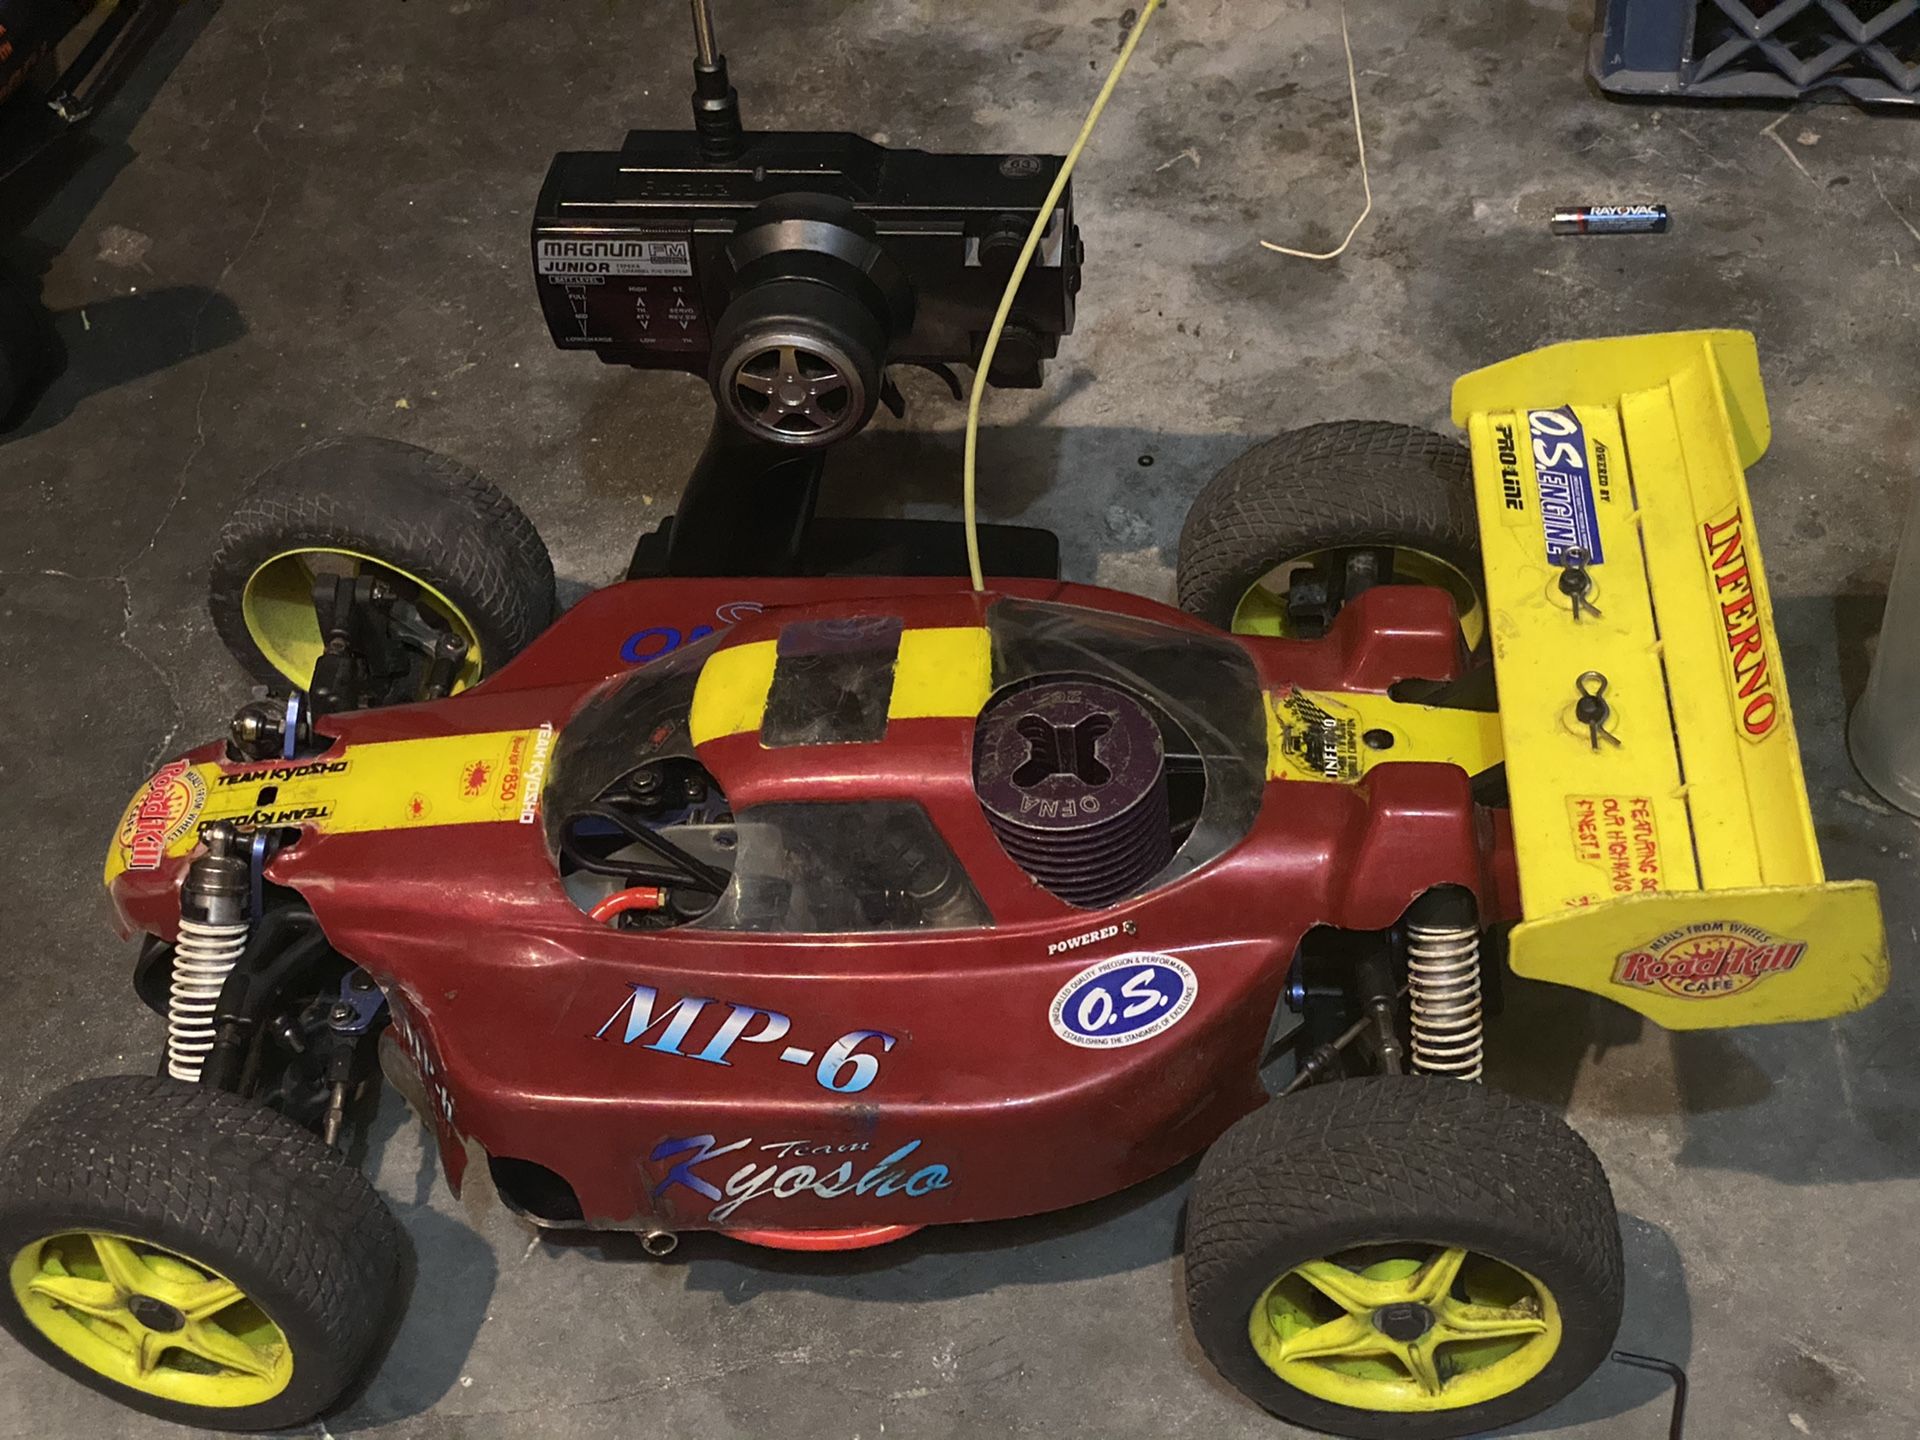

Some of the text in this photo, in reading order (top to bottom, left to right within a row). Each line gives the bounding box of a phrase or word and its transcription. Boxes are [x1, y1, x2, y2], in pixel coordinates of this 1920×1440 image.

[1590, 205, 1657, 216] RAYOVAC
[544, 242, 686, 257] MAGNUM FM
[544, 262, 610, 274] JUNIOR
[568, 293, 587, 301] FULL
[1599, 490, 1611, 503] BY
[1703, 506, 1777, 735] INFERNO
[1323, 718, 1338, 777] INFEO
[217, 761, 347, 787] TEAM KYOSHO
[520, 722, 553, 824] TEAM KYOSHO
[129, 758, 189, 869] Road Kill
[197, 806, 329, 832] TEAM KYOO
[1019, 794, 1100, 818] OFNA
[166, 812, 199, 841] WHEELS
[1602, 798, 1636, 892] OUR HIGHWAYS
[1629, 798, 1658, 873] FEATURING
[1048, 925, 1118, 955] POWERED
[1650, 921, 1773, 951] MEALS FROM WHEELS
[1621, 942, 1805, 986] Road Kill
[1053, 956, 1192, 1026] UNEQUALLED QUALITY PRECISION & PERFORMANCE
[1078, 968, 1168, 1031] O.S.
[1062, 986, 1195, 1046] ESTABLISHING THE STANDARDS OF EXCELLENCE
[592, 981, 897, 1093] MP-6
[760, 1138, 870, 1159] Team
[652, 1134, 952, 1222] Kyosho
